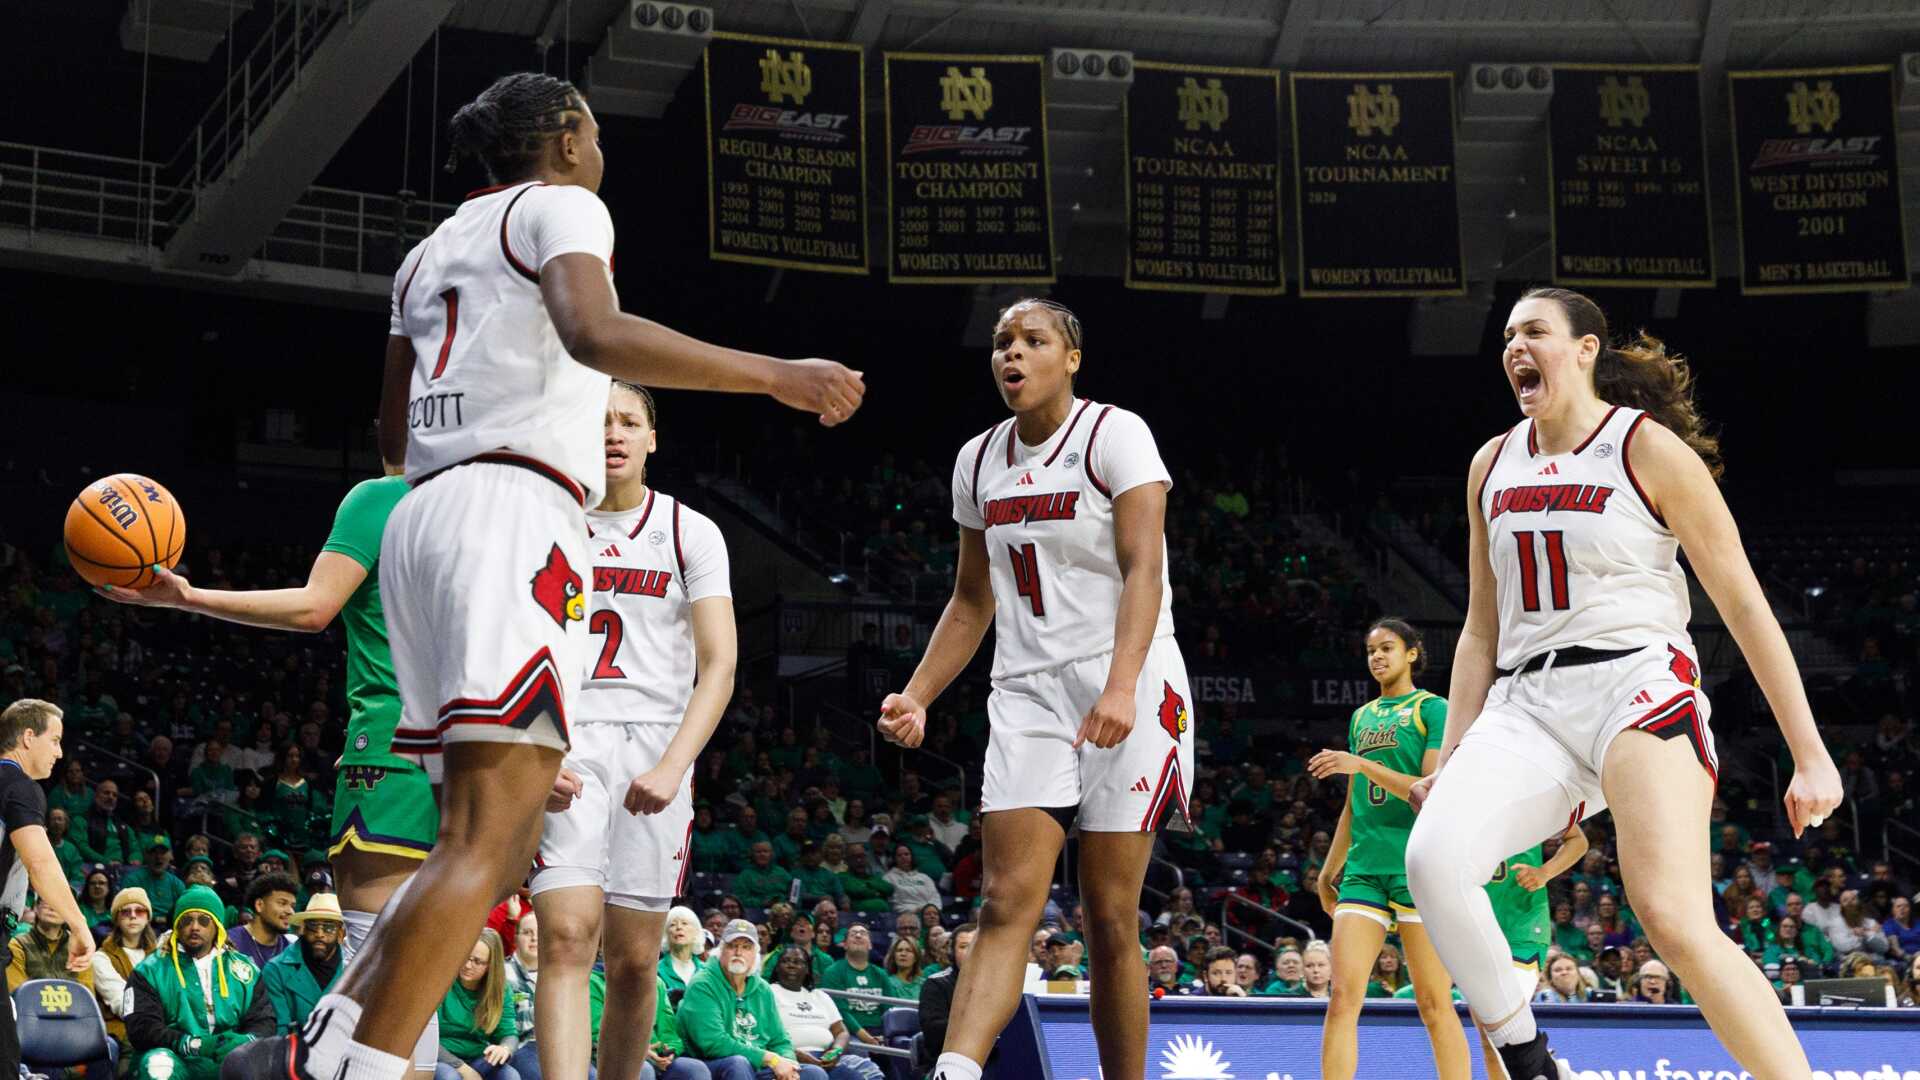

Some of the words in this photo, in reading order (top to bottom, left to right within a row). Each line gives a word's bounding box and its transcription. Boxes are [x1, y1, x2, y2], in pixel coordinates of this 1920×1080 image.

[719, 138, 793, 161] REGULAR
[799, 148, 856, 168] SEASON
[1173, 137, 1234, 156] NCAA
[1346, 144, 1409, 160] NCAA
[1597, 135, 1658, 151] NCAA
[745, 160, 833, 184] CHAMPION
[896, 162, 1039, 179] TOURNAMENT
[1134, 157, 1275, 180] TOURNAMENT
[1305, 166, 1449, 182] TOURNAMENT
[1576, 155, 1649, 174] SWEET
[916, 182, 1023, 199] CHAMPION
[1750, 174, 1800, 192] WEST
[1805, 170, 1889, 191] DIVISION
[1773, 190, 1867, 210] CHAMPION
[1798, 216, 1845, 235] 2001
[721, 231, 779, 252] WOMEN'S
[783, 238, 860, 259] VOLLEYBALL
[899, 254, 960, 270] WOMEN'S
[965, 254, 1046, 270] VOLLEYBALL
[1135, 259, 1194, 278] WOMEN'S
[1198, 264, 1275, 281] VOLLEYBALL
[1562, 256, 1622, 273] WOMEN'S
[1627, 257, 1705, 274] VOLLEYBALL
[1760, 263, 1801, 281] MEN'S
[1807, 260, 1890, 280] BASKETBALL
[1311, 267, 1370, 283] WOMEN'S
[1375, 267, 1457, 283] VOLLEYBALL
[430, 286, 460, 381] 1
[409, 393, 464, 429] COTT
[1490, 484, 1615, 522] LOUISVILLE
[1007, 543, 1045, 617] 4
[1511, 531, 1570, 612] 11
[589, 608, 627, 680] 2
[1312, 679, 1369, 704] LEAH
